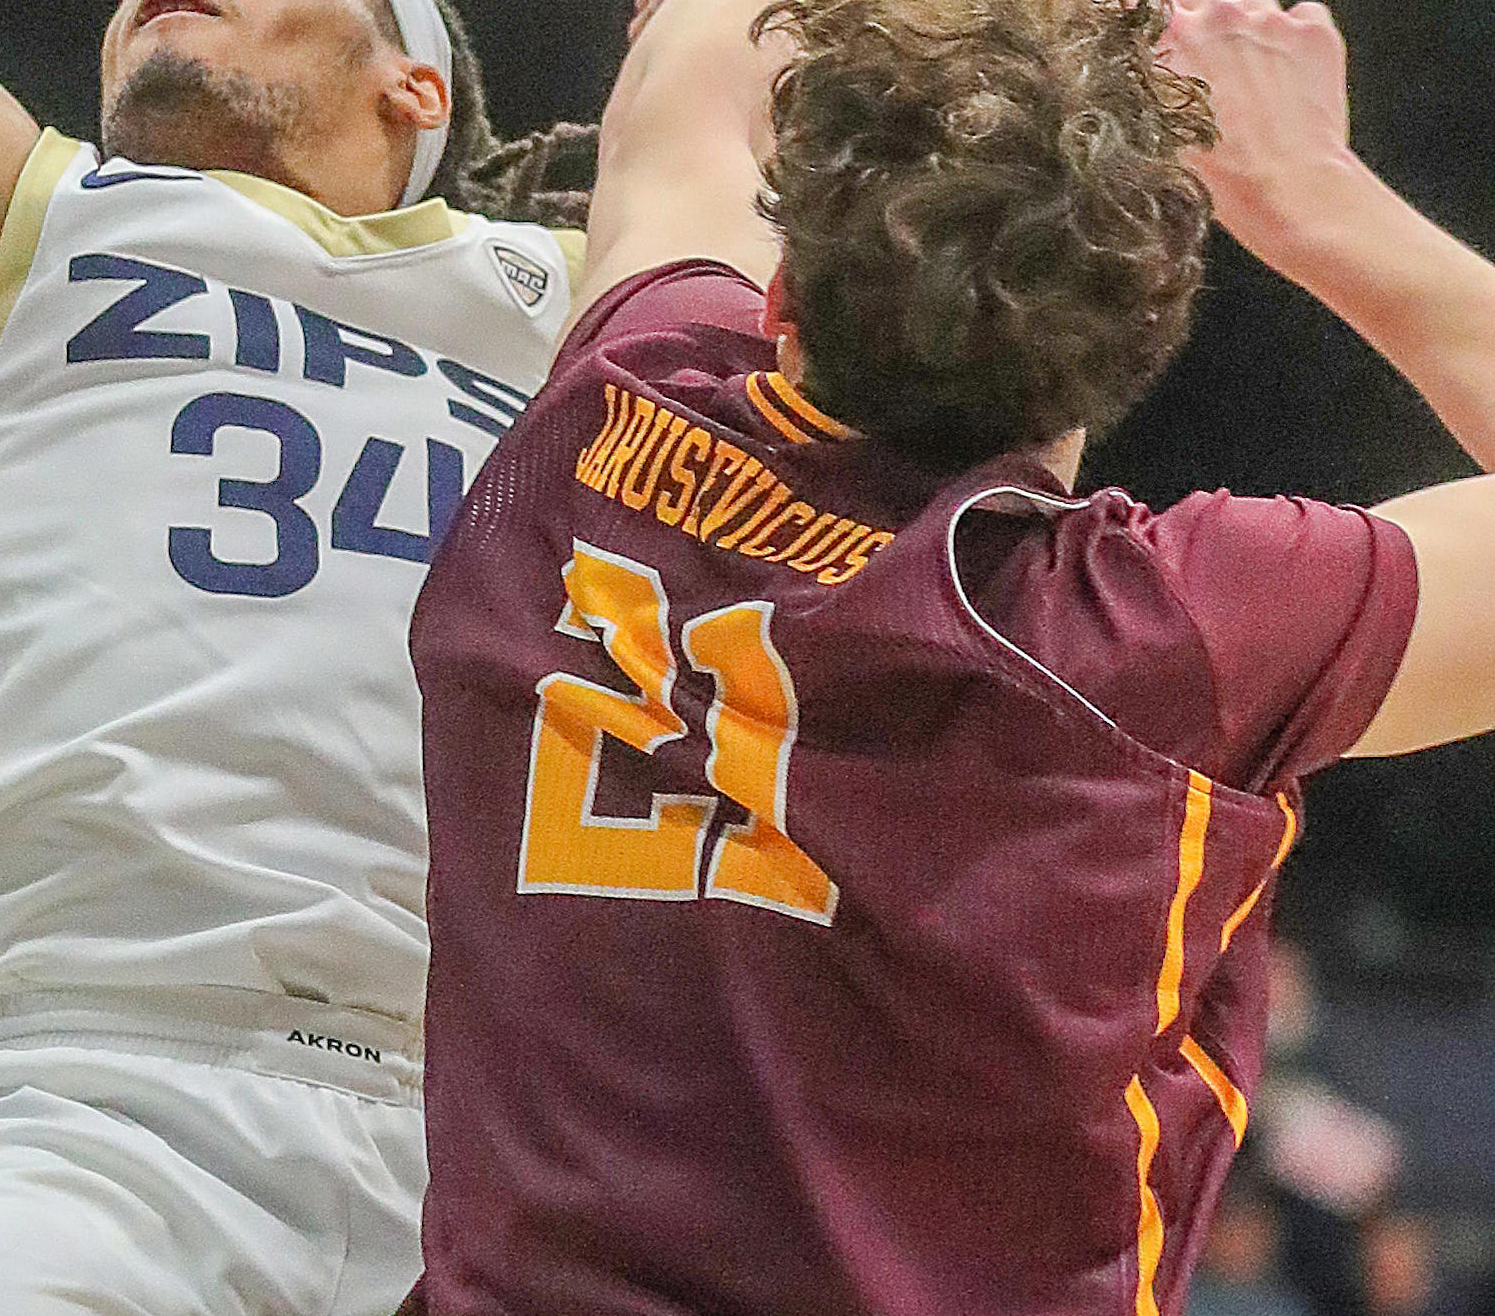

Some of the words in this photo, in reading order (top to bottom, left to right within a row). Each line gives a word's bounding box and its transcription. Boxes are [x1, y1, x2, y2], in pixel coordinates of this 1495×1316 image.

[65, 252, 534, 439] ZIPS
[167, 391, 467, 599] 34
[516, 536, 840, 927] 21
[287, 1029, 382, 1064] AKRON
